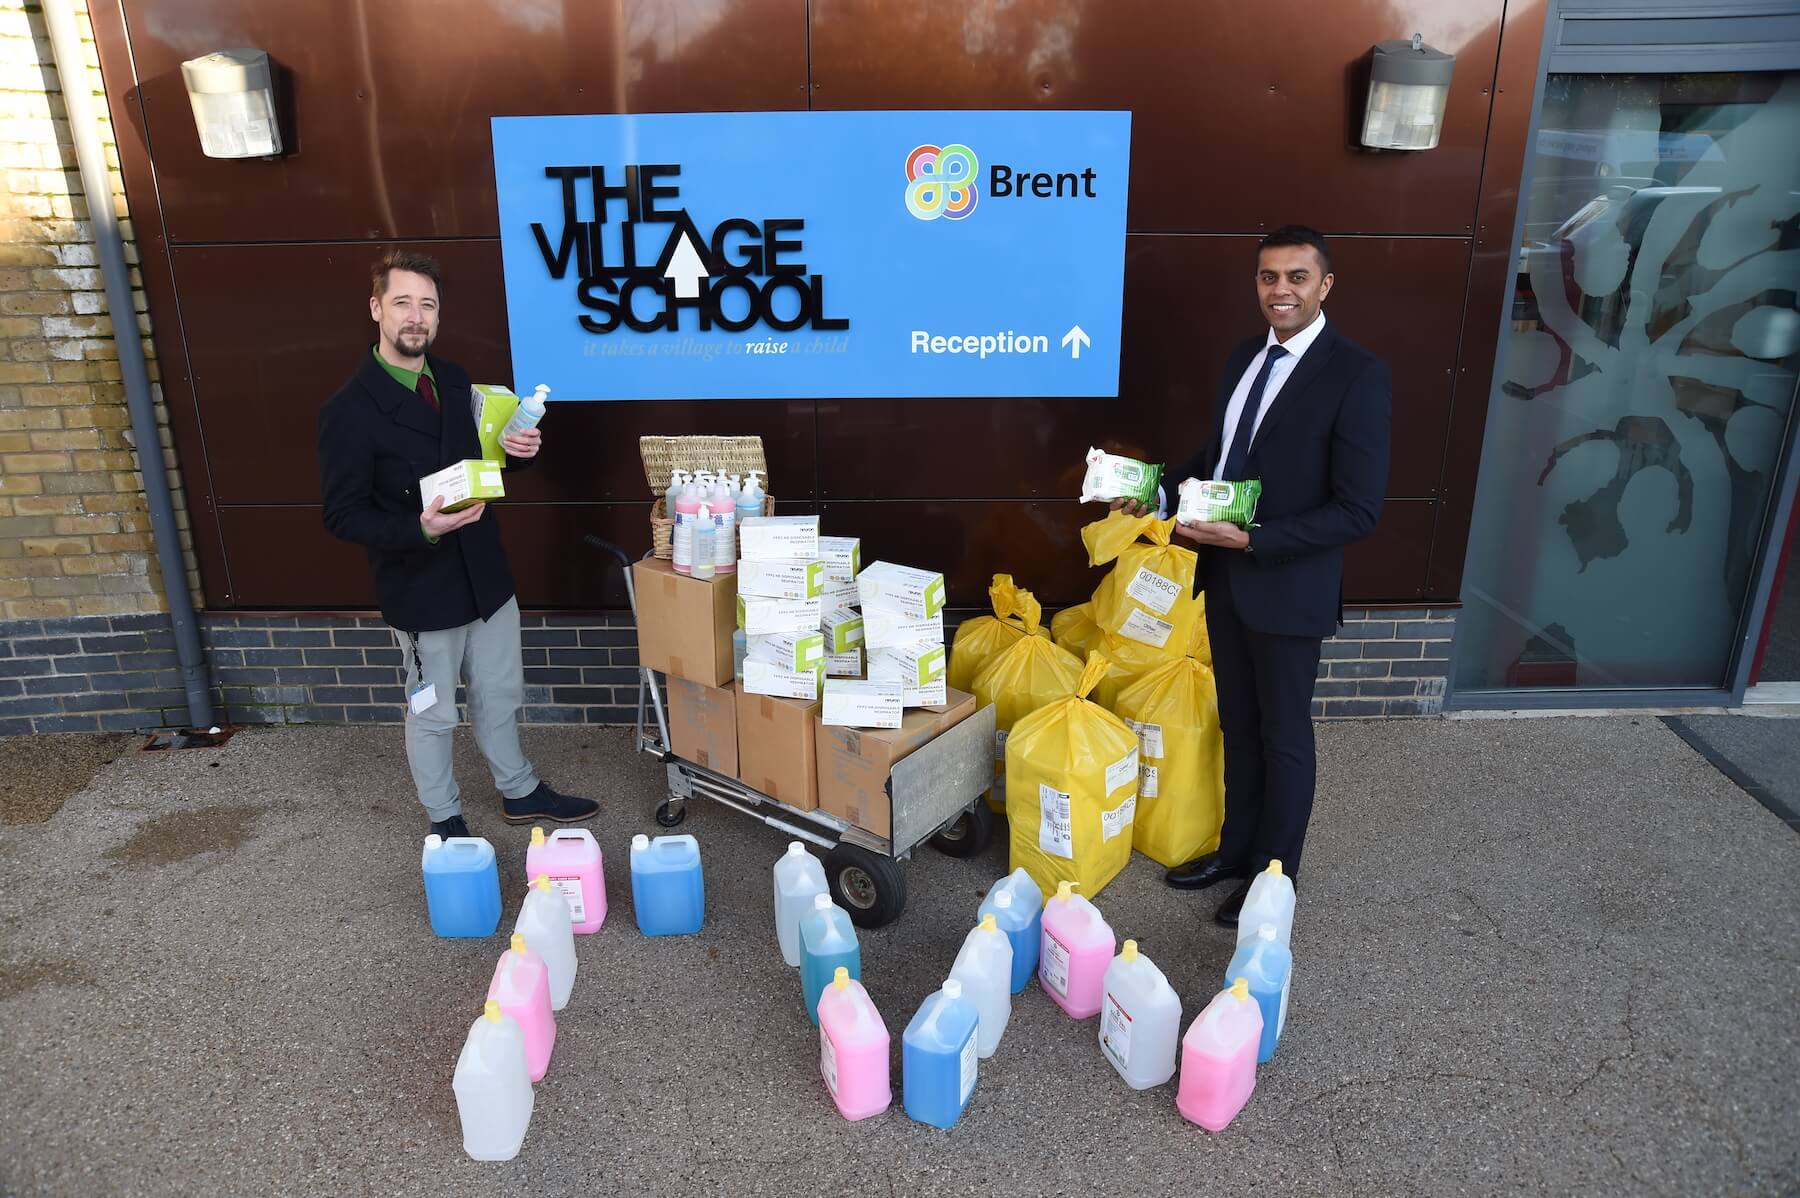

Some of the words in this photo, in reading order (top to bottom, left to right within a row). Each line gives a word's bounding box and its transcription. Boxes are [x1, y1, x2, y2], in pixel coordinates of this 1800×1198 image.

[545, 164, 681, 224] THE
[990, 165, 1097, 198] Brent
[530, 208, 807, 281] VILLAGE
[577, 274, 850, 334] SCHOOL
[583, 339, 597, 356] it
[601, 338, 644, 356] takes
[648, 344, 658, 355] a
[661, 338, 721, 360] village
[727, 340, 741, 355] to
[745, 337, 788, 354] raise
[790, 342, 800, 353] a
[805, 336, 849, 353] child
[911, 330, 1048, 359] Reception
